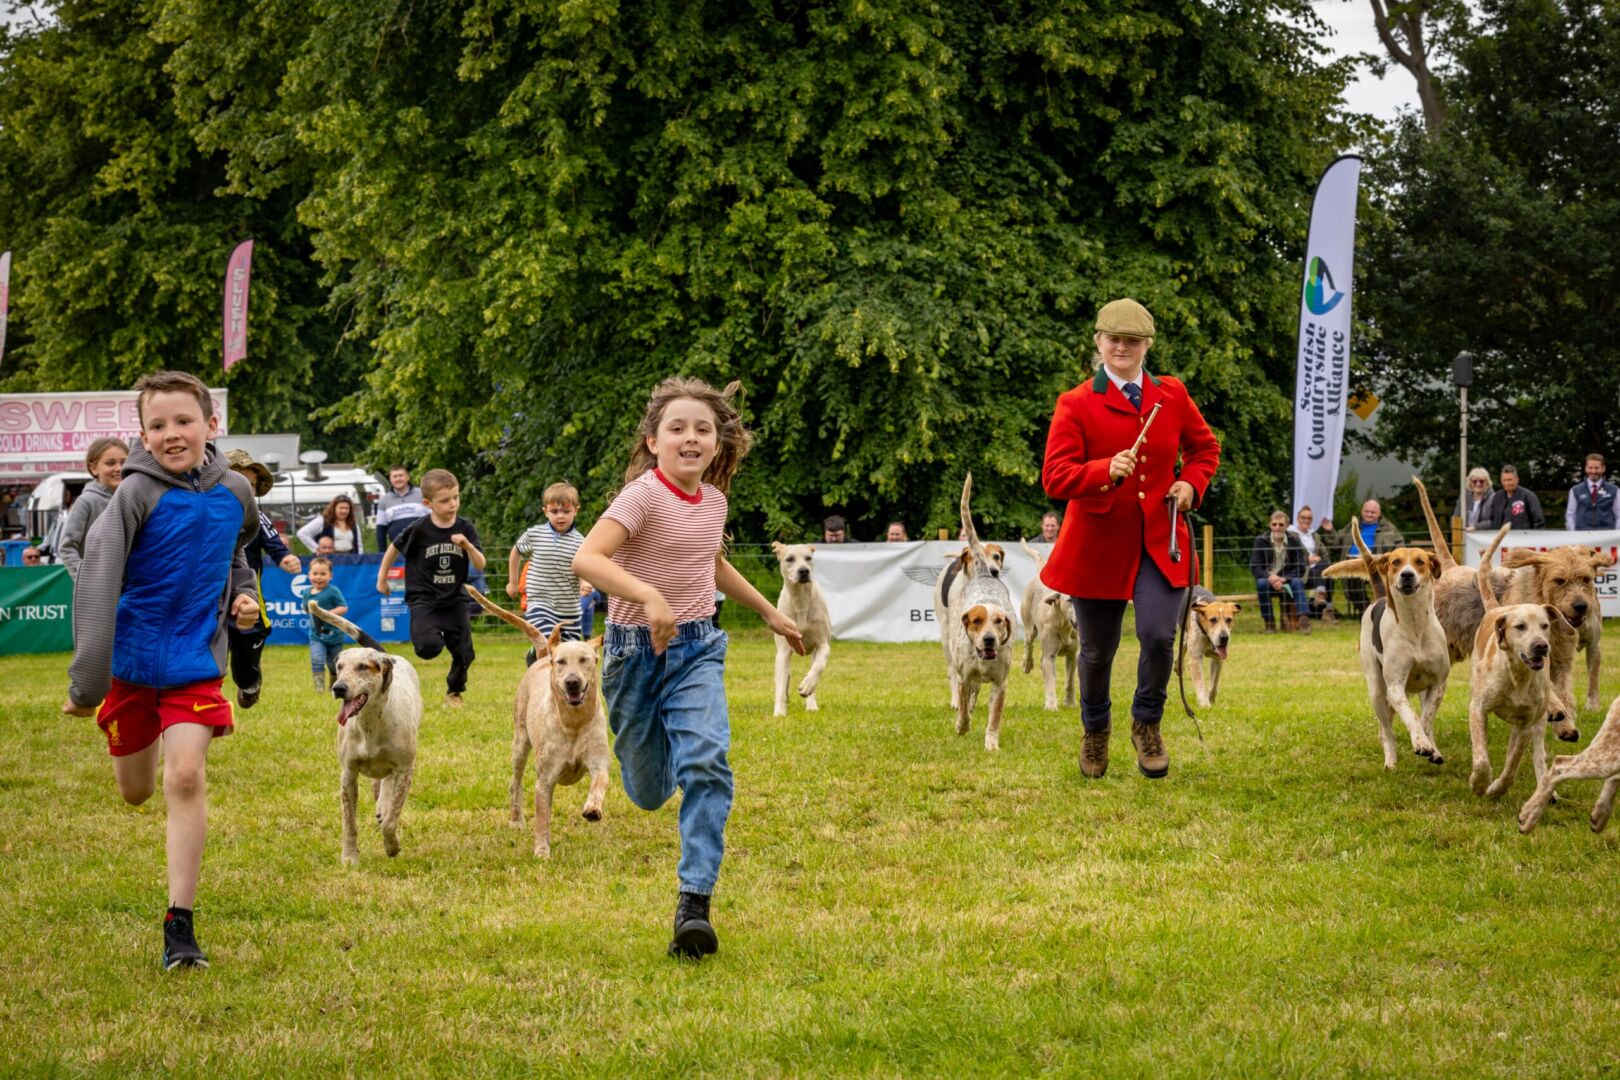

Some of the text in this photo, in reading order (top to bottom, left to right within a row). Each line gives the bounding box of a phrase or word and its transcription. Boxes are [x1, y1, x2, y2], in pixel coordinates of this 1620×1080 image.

[1301, 322, 1316, 411] Scottish
[1307, 326, 1327, 460] Countryside
[1327, 330, 1345, 416] Alliance
[25, 432, 64, 452] DRINKS
[433, 575, 456, 583] POWER
[15, 604, 68, 620] TRUST
